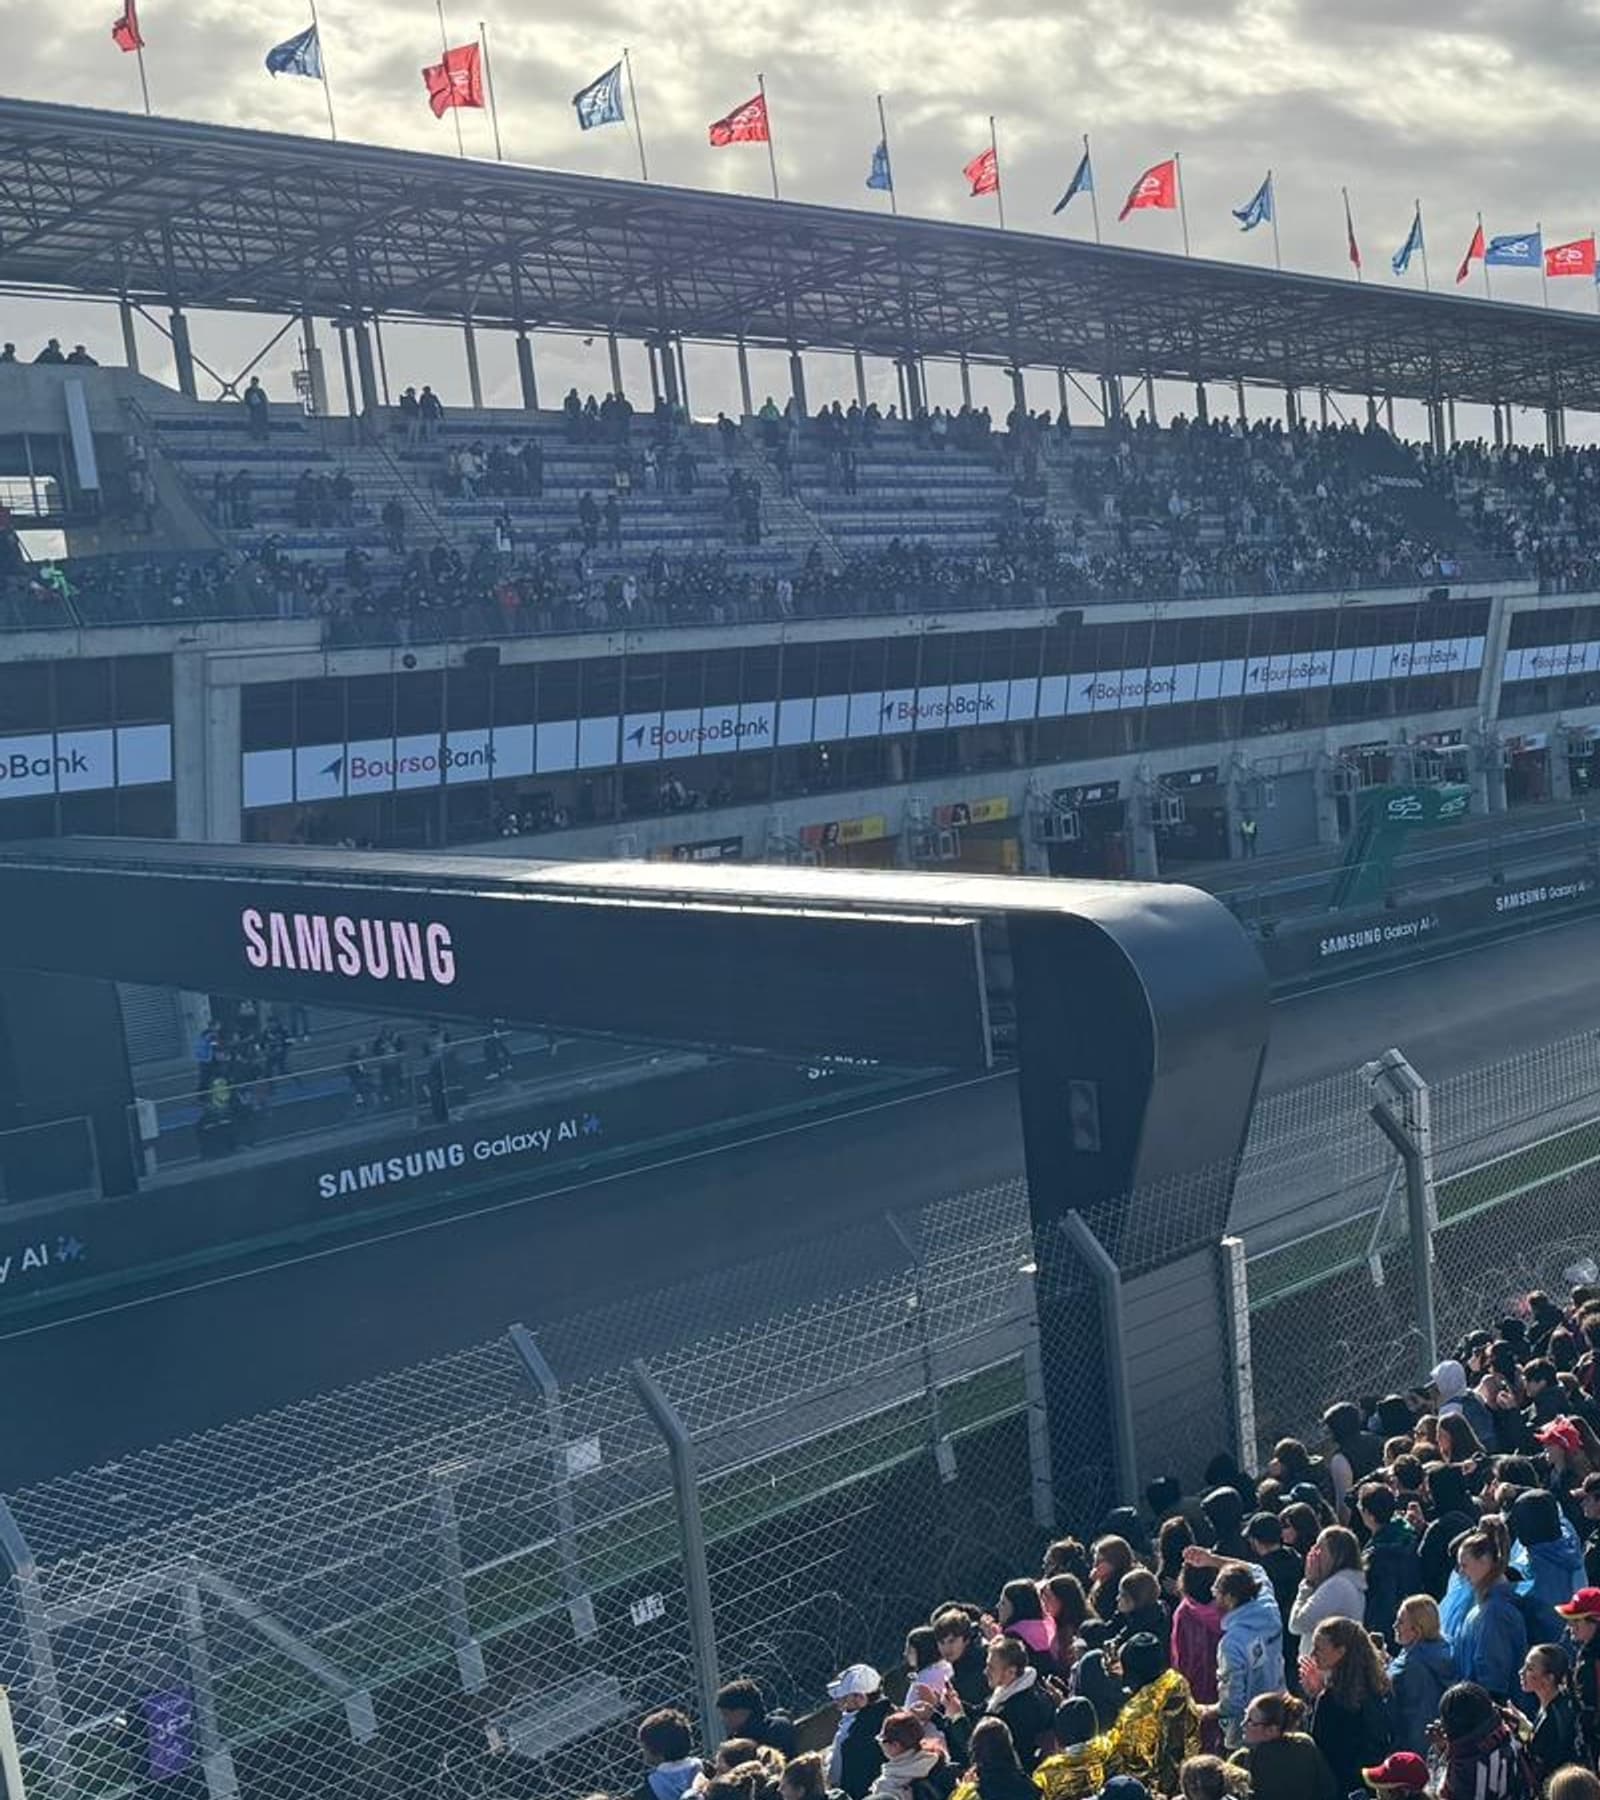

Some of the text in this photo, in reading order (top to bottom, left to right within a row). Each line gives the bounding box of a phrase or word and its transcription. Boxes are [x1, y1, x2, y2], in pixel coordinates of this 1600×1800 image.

[1261, 662, 1329, 682] BoursoBank
[1097, 678, 1176, 698] BoursoBank
[898, 694, 995, 719] BoursoBank
[650, 716, 769, 745] BoursoBank
[351, 744, 497, 779] BoursoBank
[1496, 888, 1547, 911] SAMSUNG
[242, 908, 455, 985] SAMSUNG
[1320, 927, 1381, 955] SAMSUNG
[1384, 921, 1419, 940] Galaxy
[319, 1120, 577, 1198] SAMSUNG Galaxy AI
[21, 1245, 48, 1271] AI
